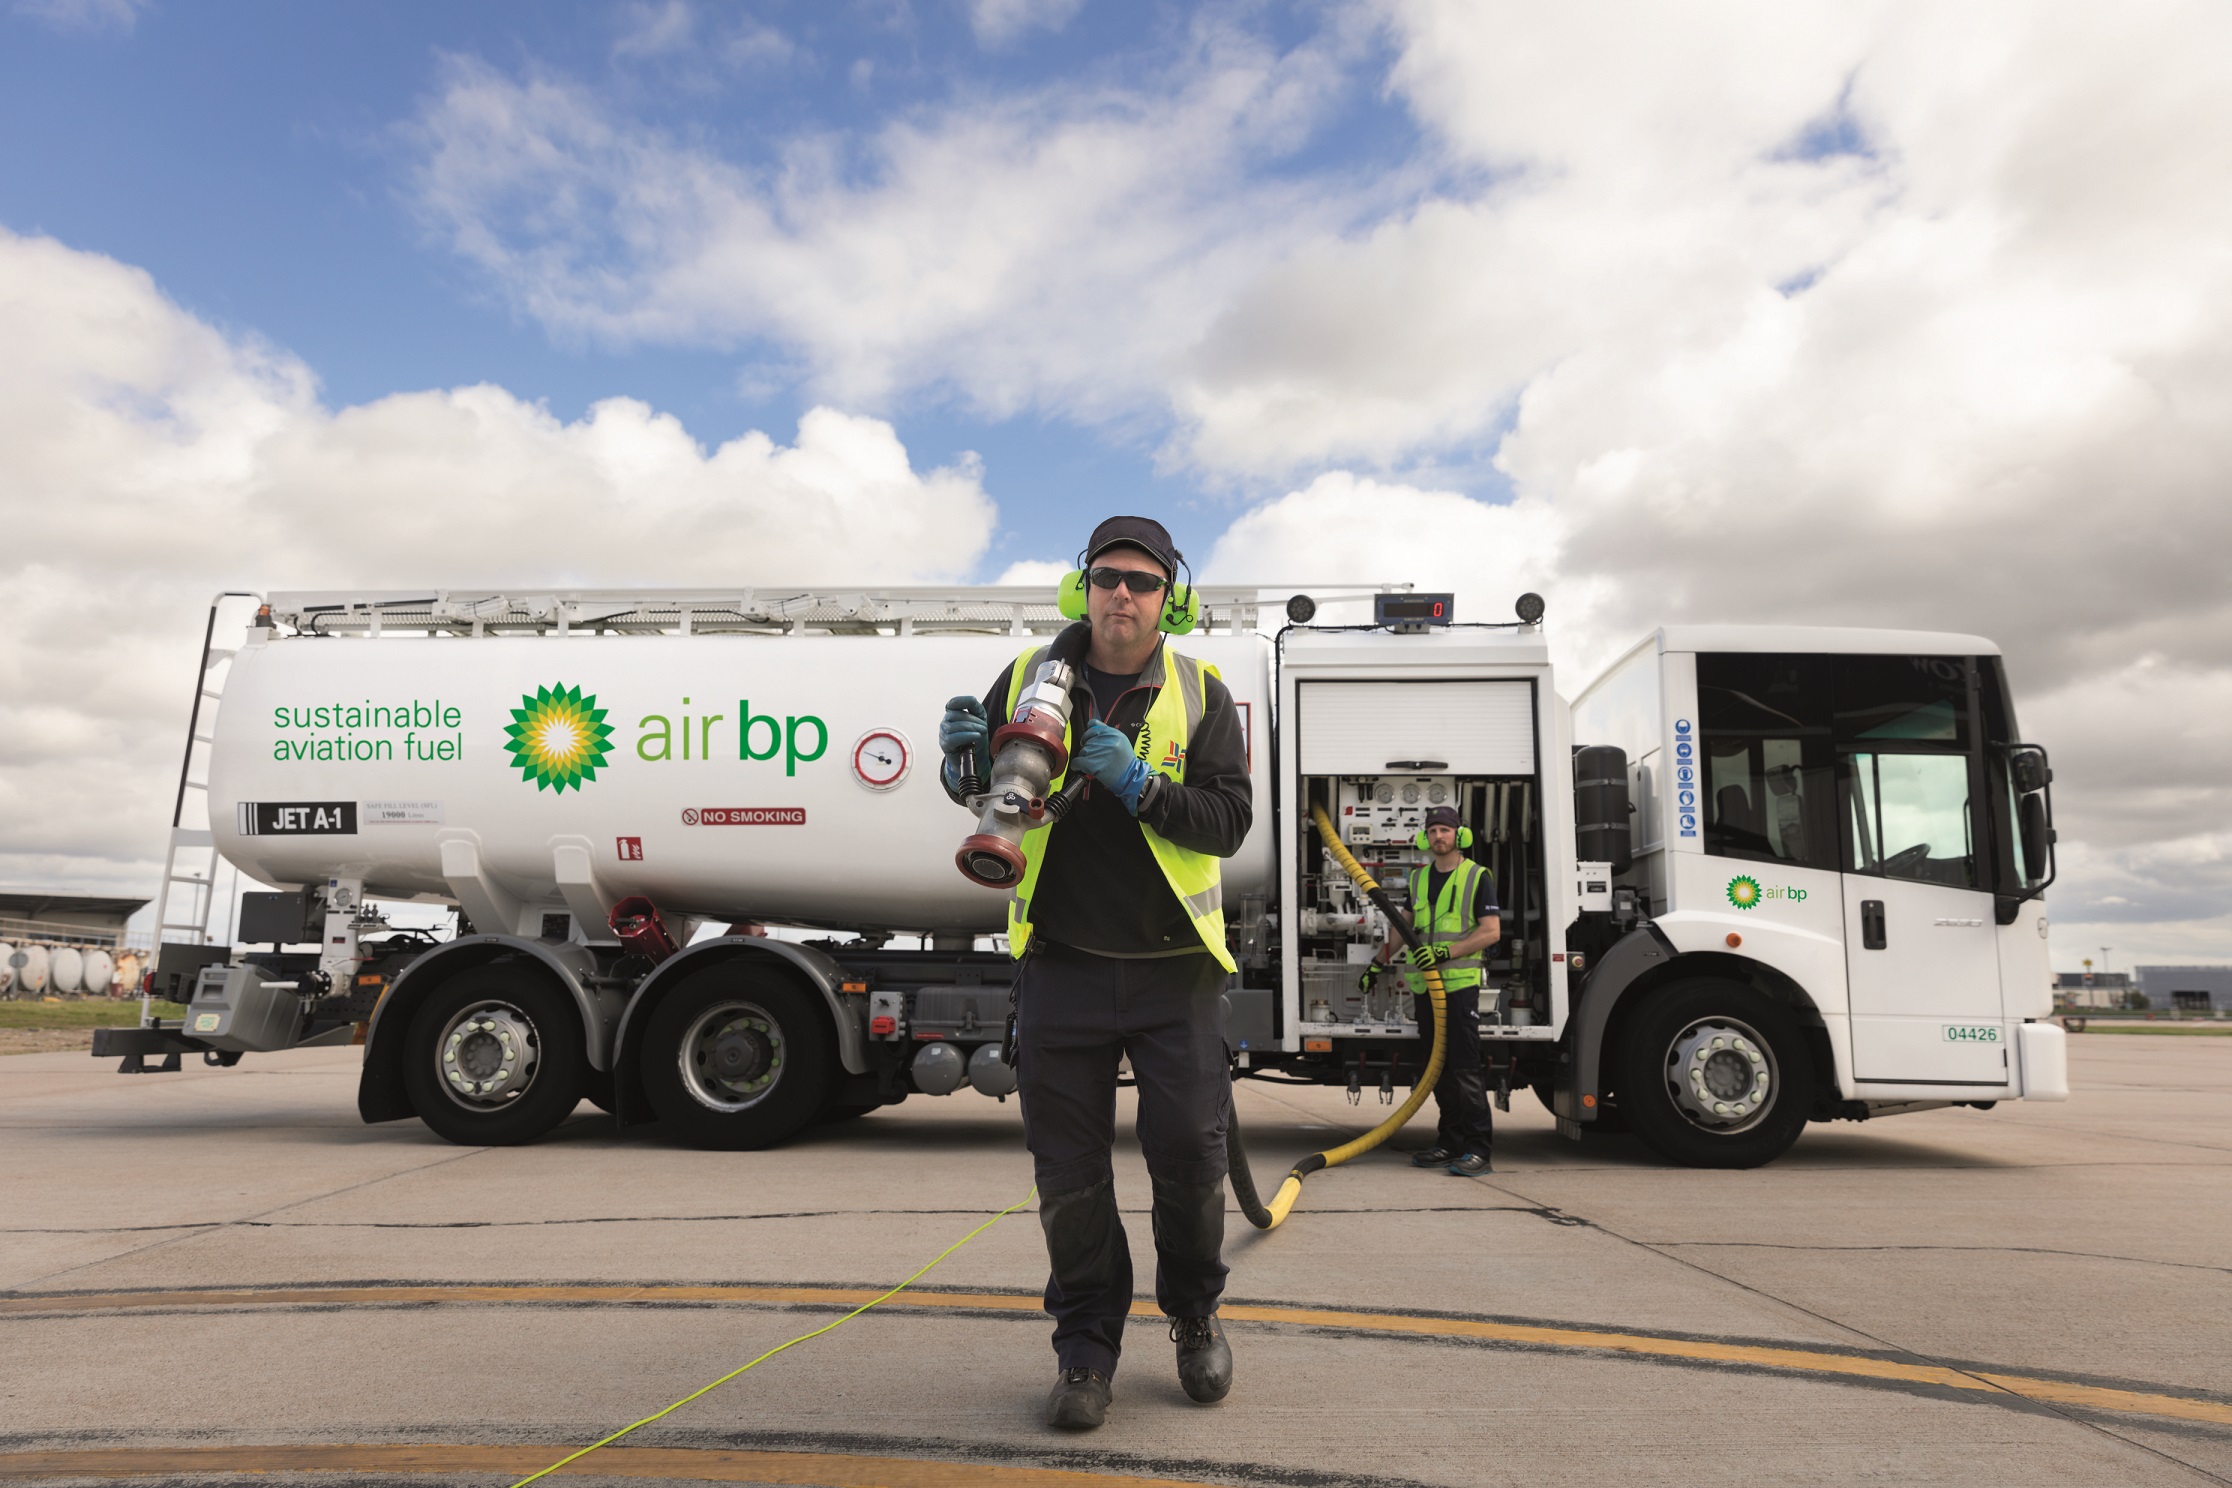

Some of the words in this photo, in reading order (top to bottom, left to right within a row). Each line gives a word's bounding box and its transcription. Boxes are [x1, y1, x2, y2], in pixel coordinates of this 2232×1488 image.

[1433, 602, 1443, 617] 0
[273, 699, 462, 729] sustainable
[273, 732, 393, 761] aviation
[404, 731, 462, 761] fuel
[637, 697, 724, 761] air
[739, 699, 829, 777] bp
[272, 808, 310, 829] JET
[313, 807, 342, 829] A-1
[703, 811, 726, 823] NO
[730, 811, 803, 823] SMOKING
[1766, 885, 1785, 899] air
[1787, 886, 1807, 903] bp
[1948, 1027, 1997, 1041] 04426
